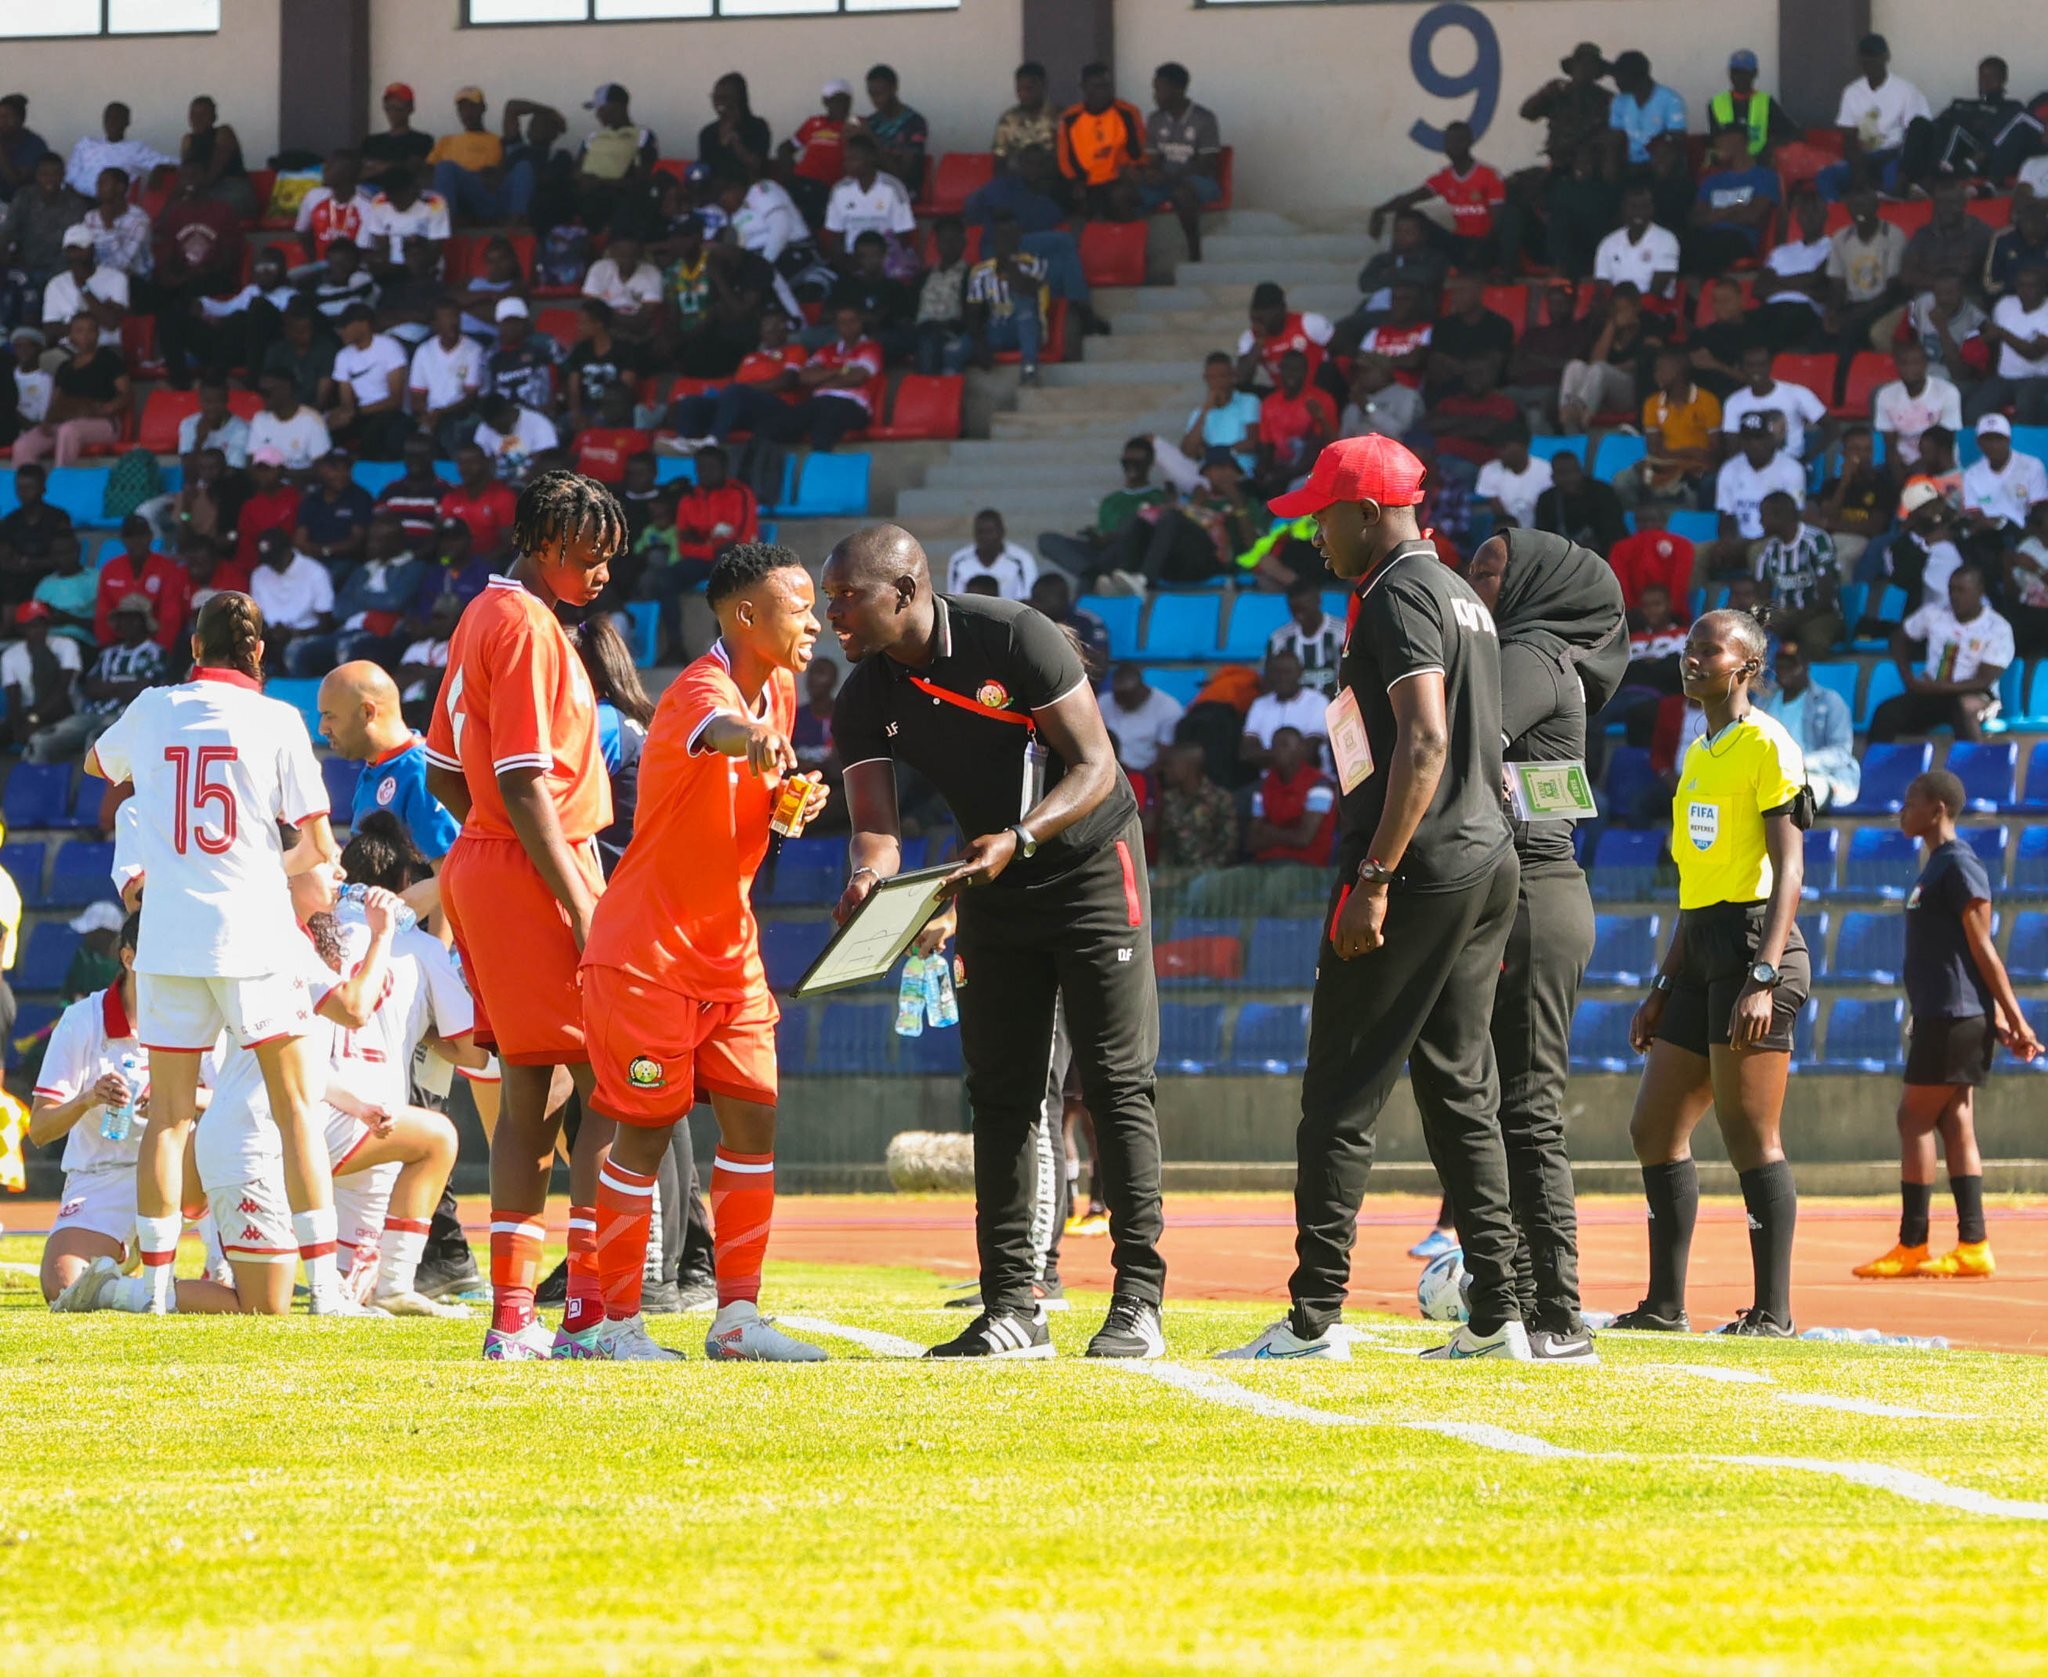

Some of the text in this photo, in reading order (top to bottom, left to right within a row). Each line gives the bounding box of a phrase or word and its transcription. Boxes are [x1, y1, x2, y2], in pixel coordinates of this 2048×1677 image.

[1408, 3, 1501, 153] 9
[164, 746, 238, 855] 15
[1690, 824, 1714, 833] REFEREE
[1691, 805, 1714, 819] FIFA
